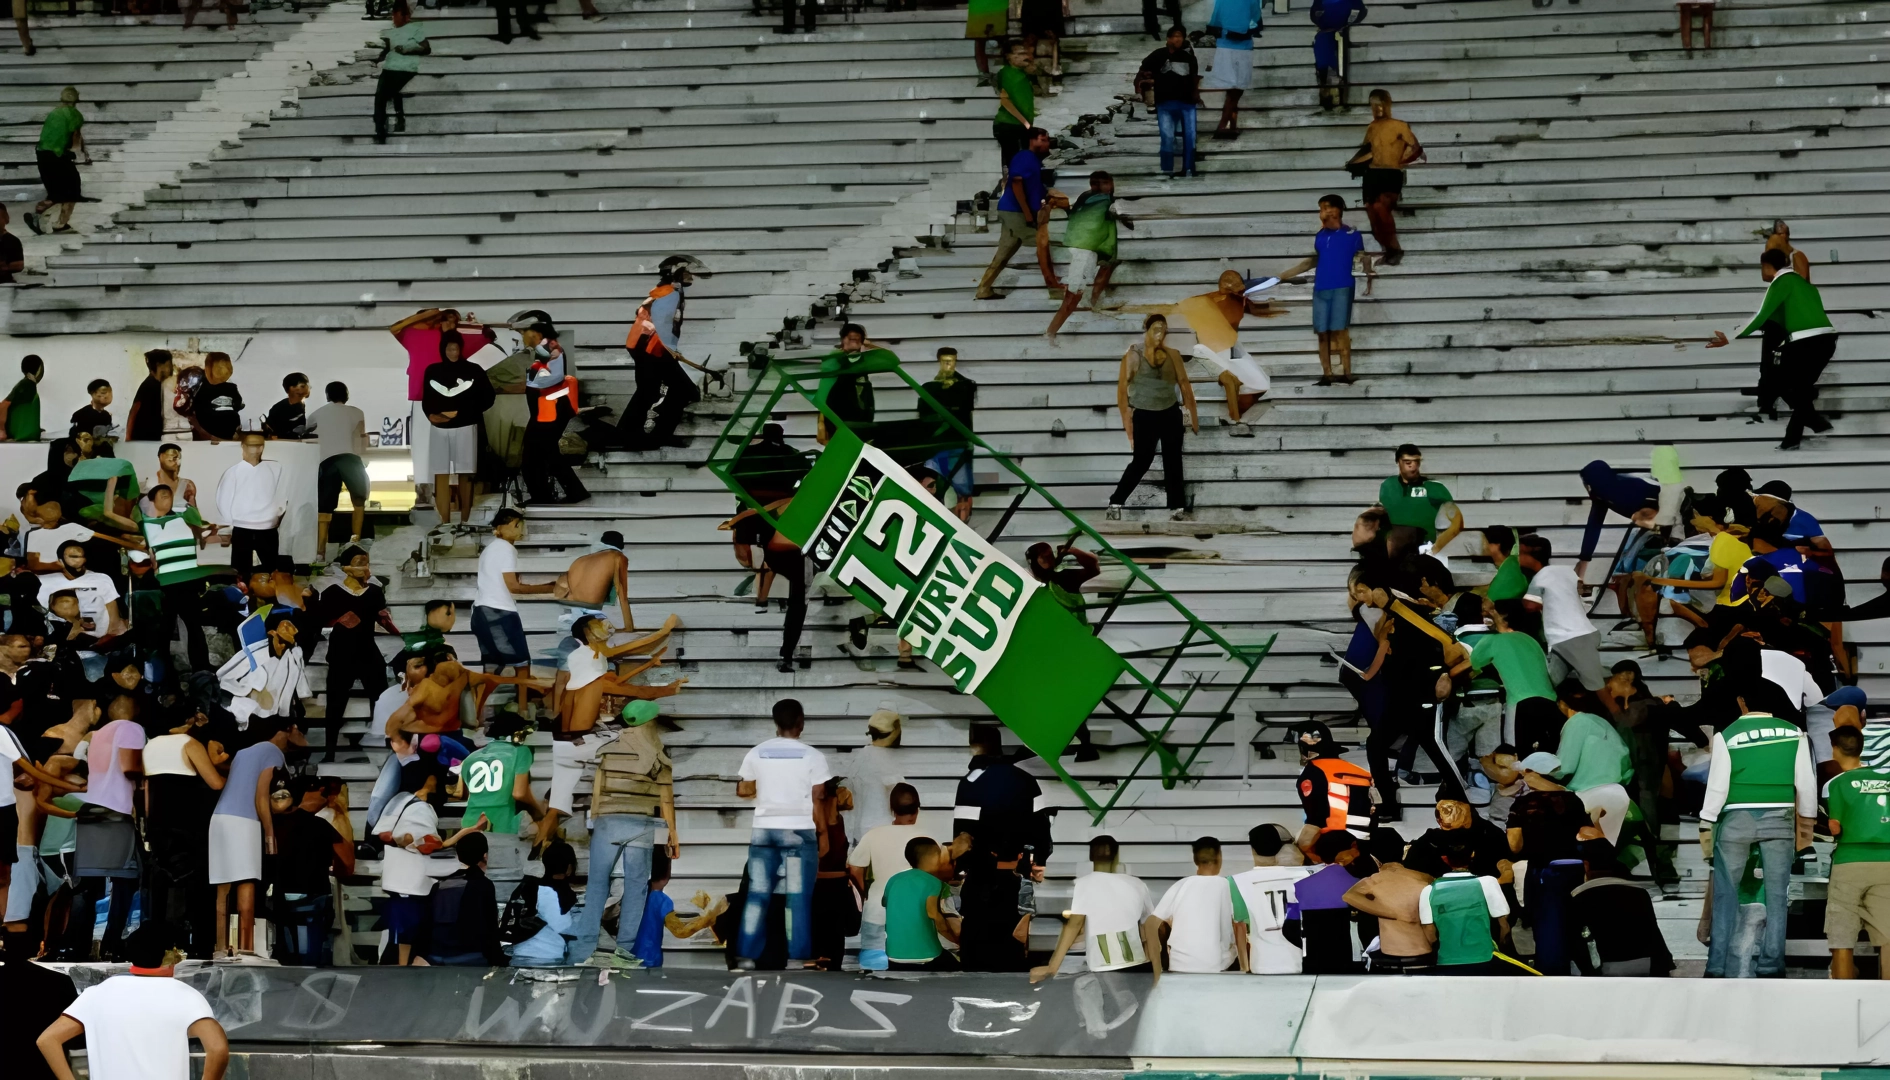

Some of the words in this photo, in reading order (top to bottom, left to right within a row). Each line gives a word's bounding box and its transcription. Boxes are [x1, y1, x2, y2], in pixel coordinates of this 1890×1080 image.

[837, 498, 945, 620] 12
[898, 537, 985, 656] CURVA
[931, 560, 1024, 694] SUD
